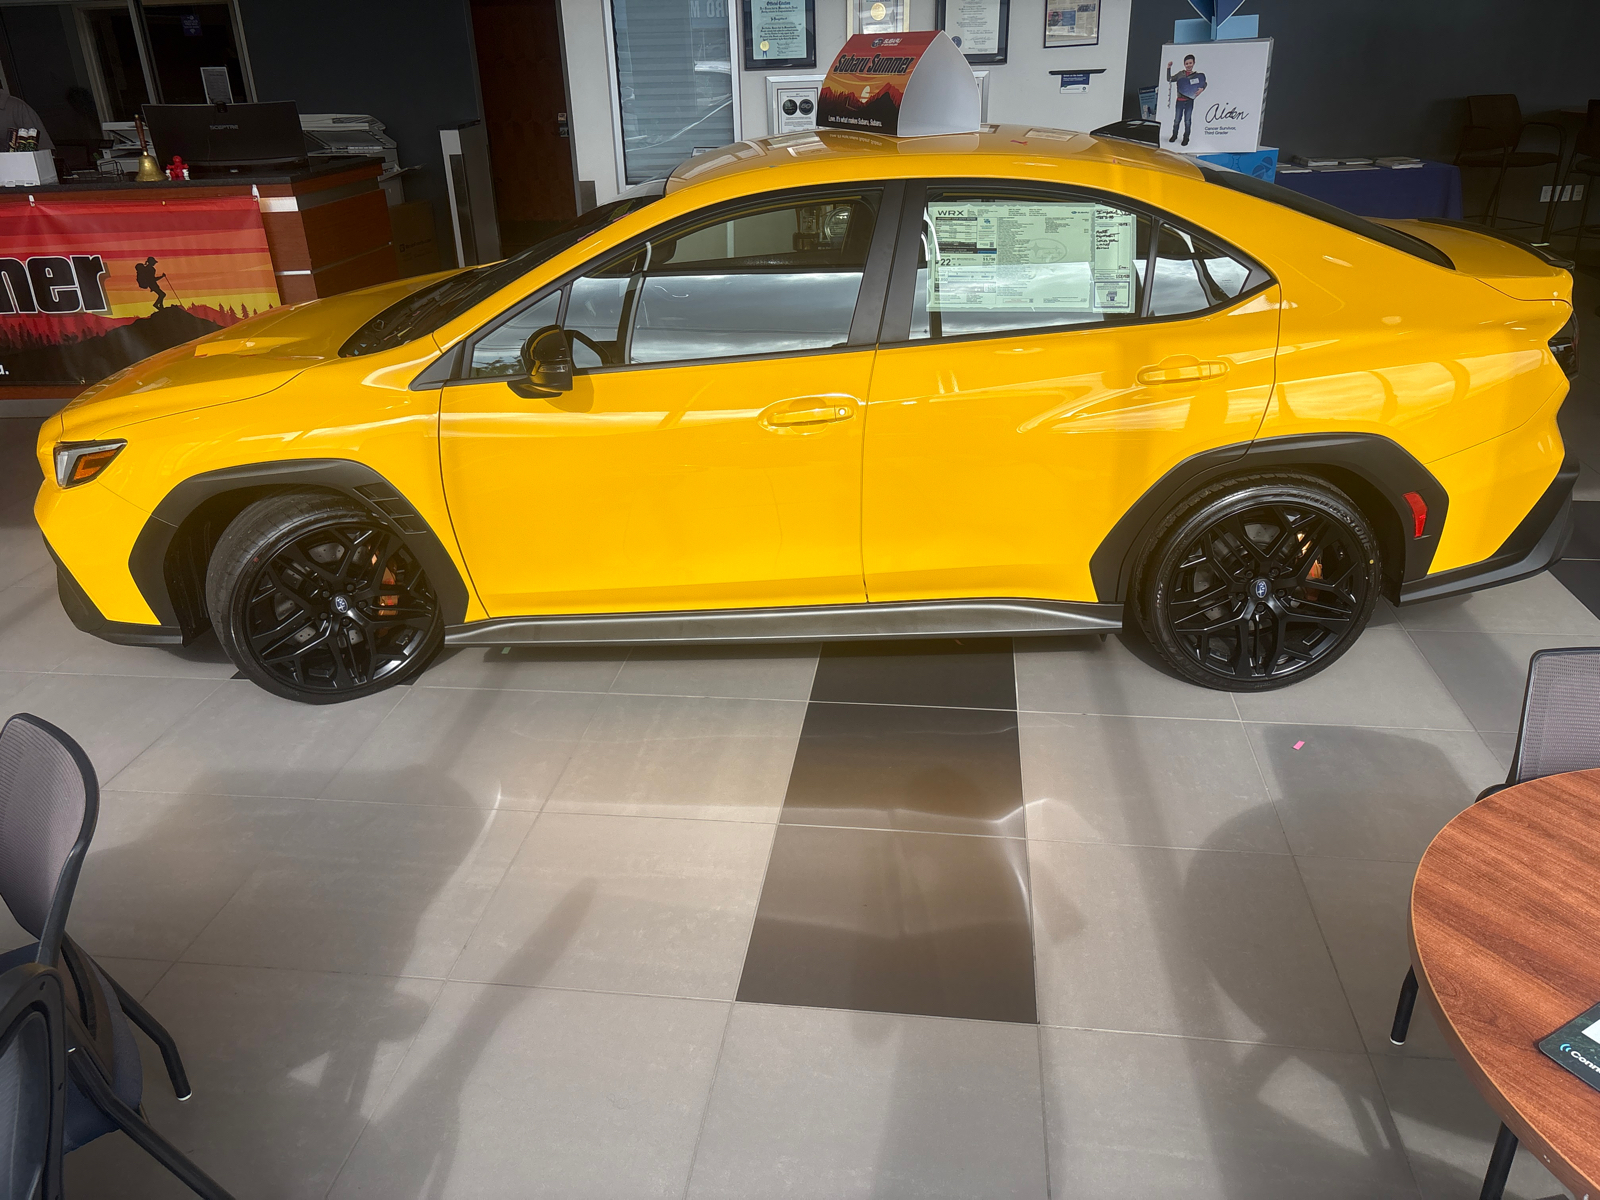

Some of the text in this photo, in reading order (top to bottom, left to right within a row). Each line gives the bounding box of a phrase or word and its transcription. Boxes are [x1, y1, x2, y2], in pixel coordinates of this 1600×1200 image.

[834, 54, 915, 74] Subaru Summer
[1205, 102, 1250, 124] Aiden
[940, 258, 951, 266] 22
[1570, 1050, 1600, 1075] Conn
